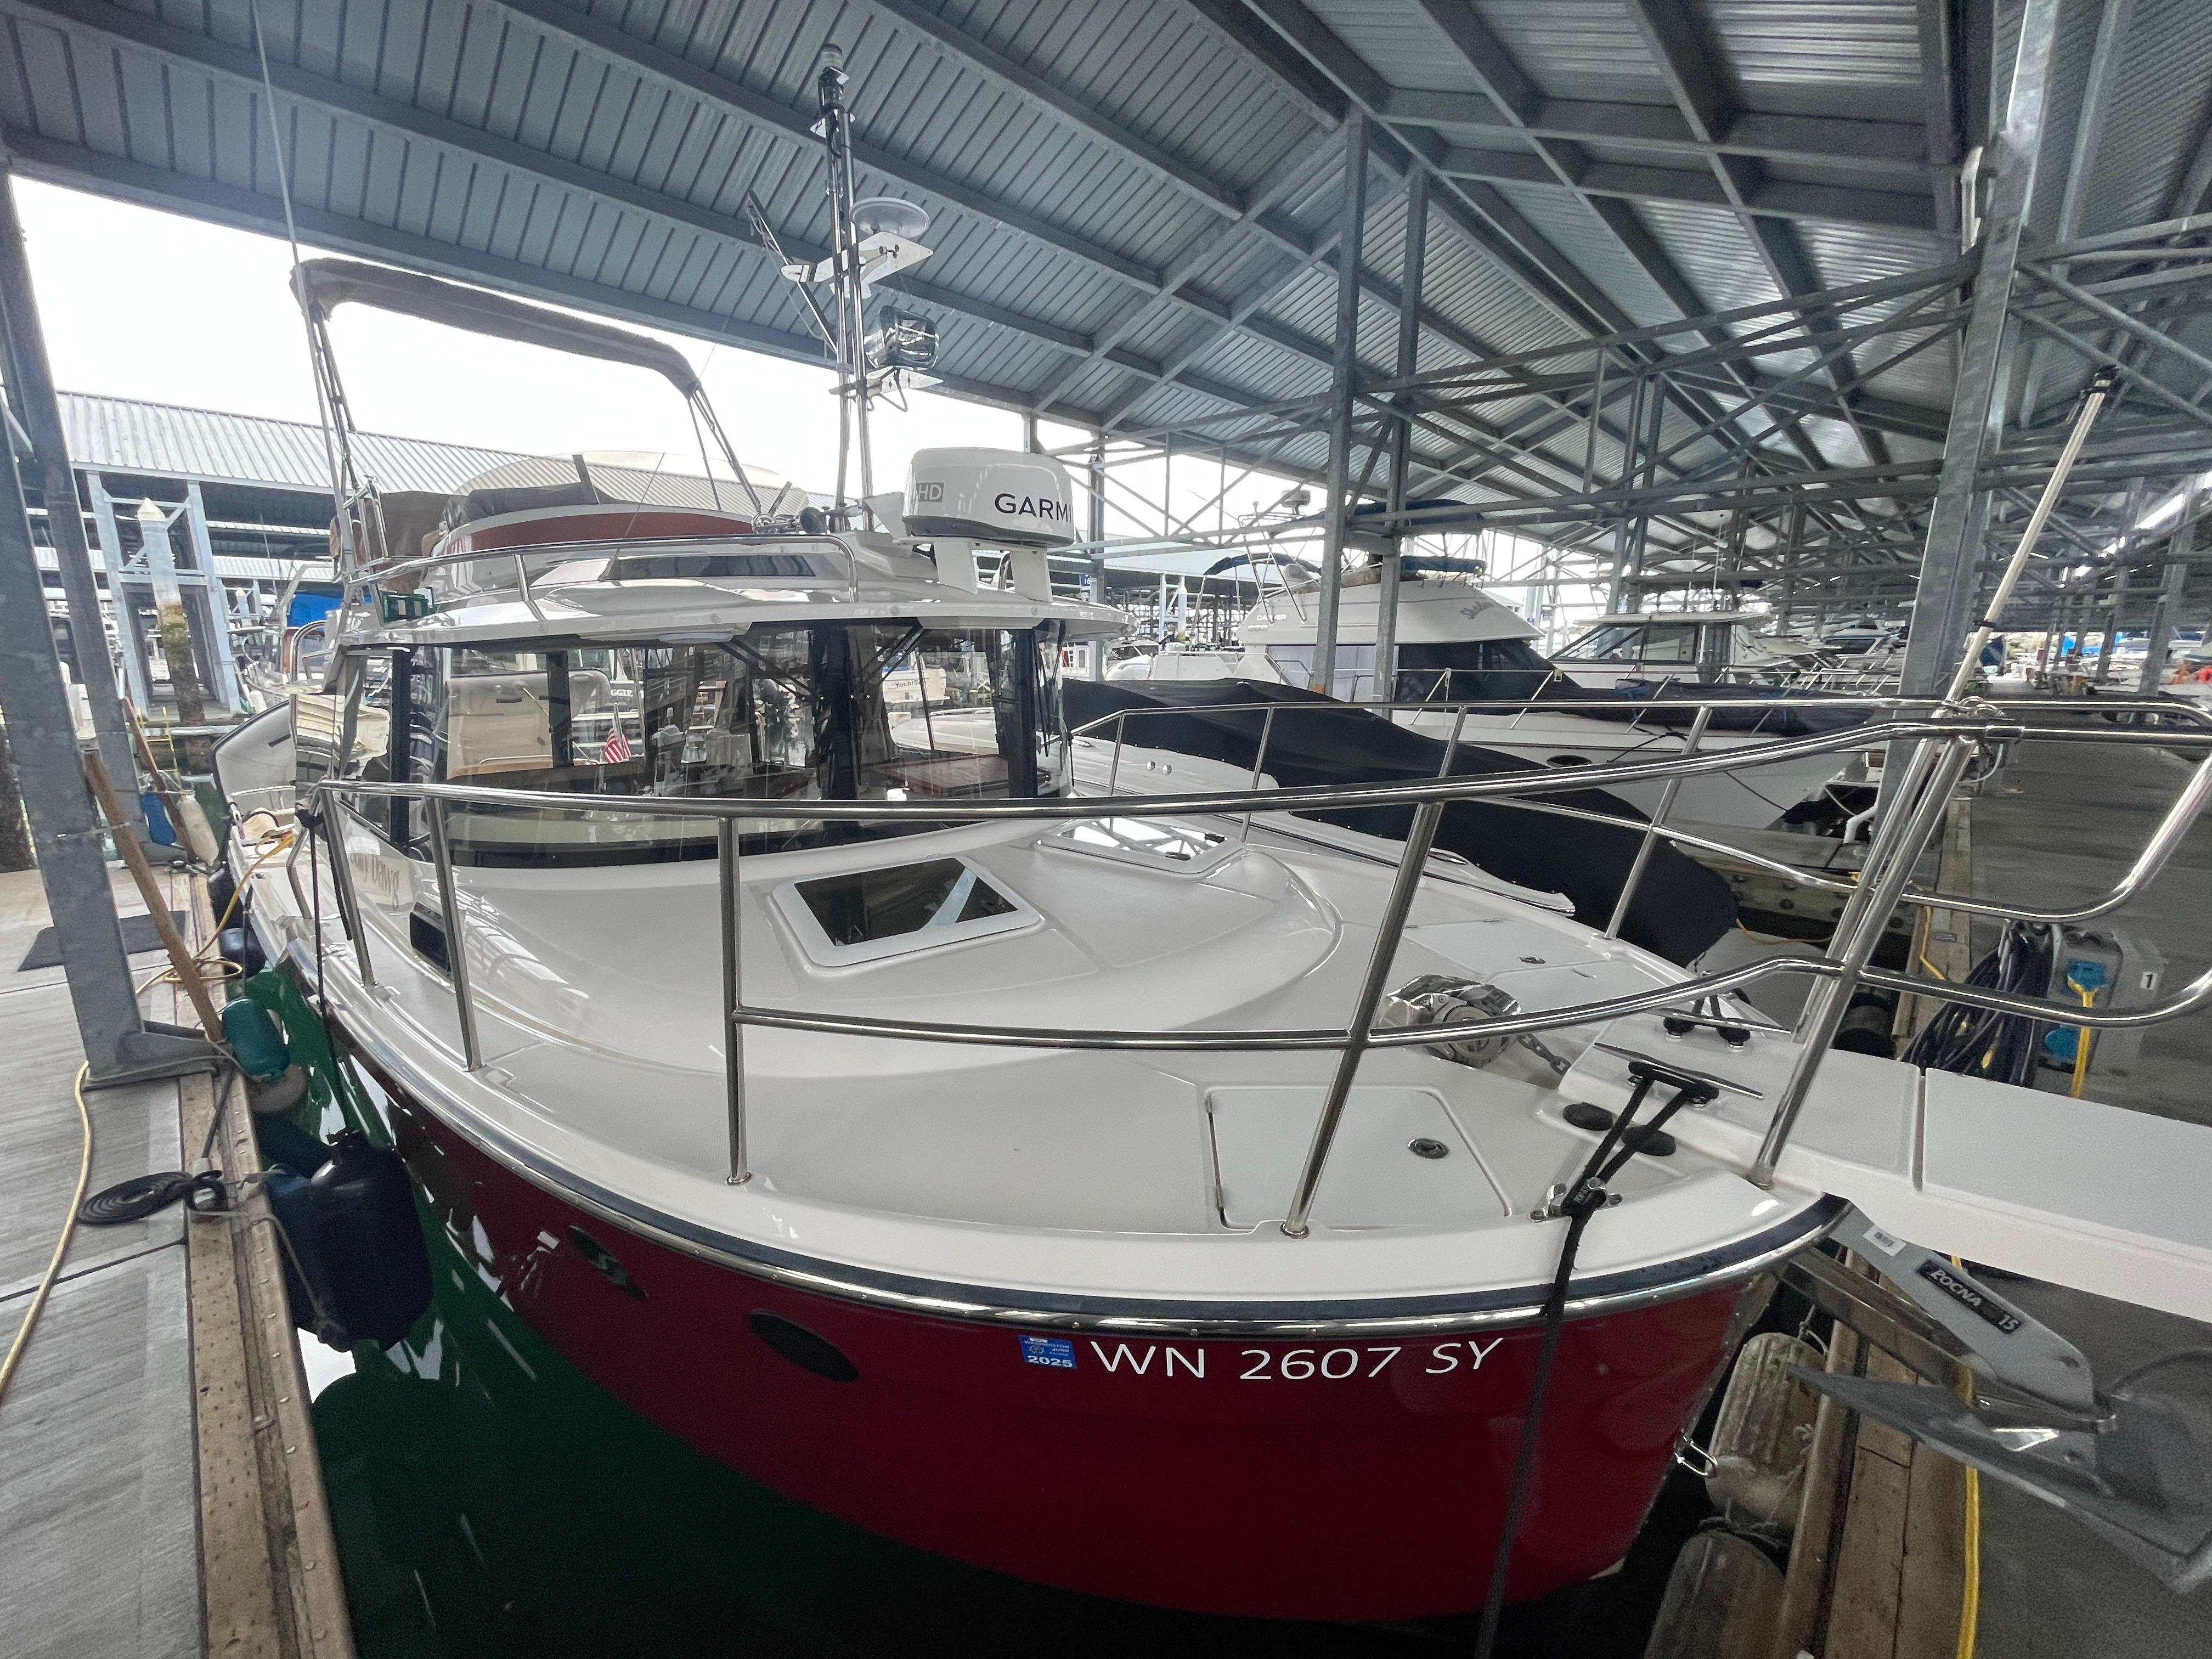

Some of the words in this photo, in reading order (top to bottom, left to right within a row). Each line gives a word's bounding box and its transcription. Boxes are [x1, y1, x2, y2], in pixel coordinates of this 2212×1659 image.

[918, 484, 942, 500] HD
[994, 493, 1072, 523] GARMI
[2146, 973, 2153, 989] 1
[1930, 1269, 1982, 1307] ROCNA
[1997, 1313, 2019, 1331] 15
[1027, 1355, 1074, 1368] 2025
[1090, 1341, 1205, 1379] WN
[1239, 1346, 1402, 1380] 2607
[1425, 1337, 1504, 1374] SY
